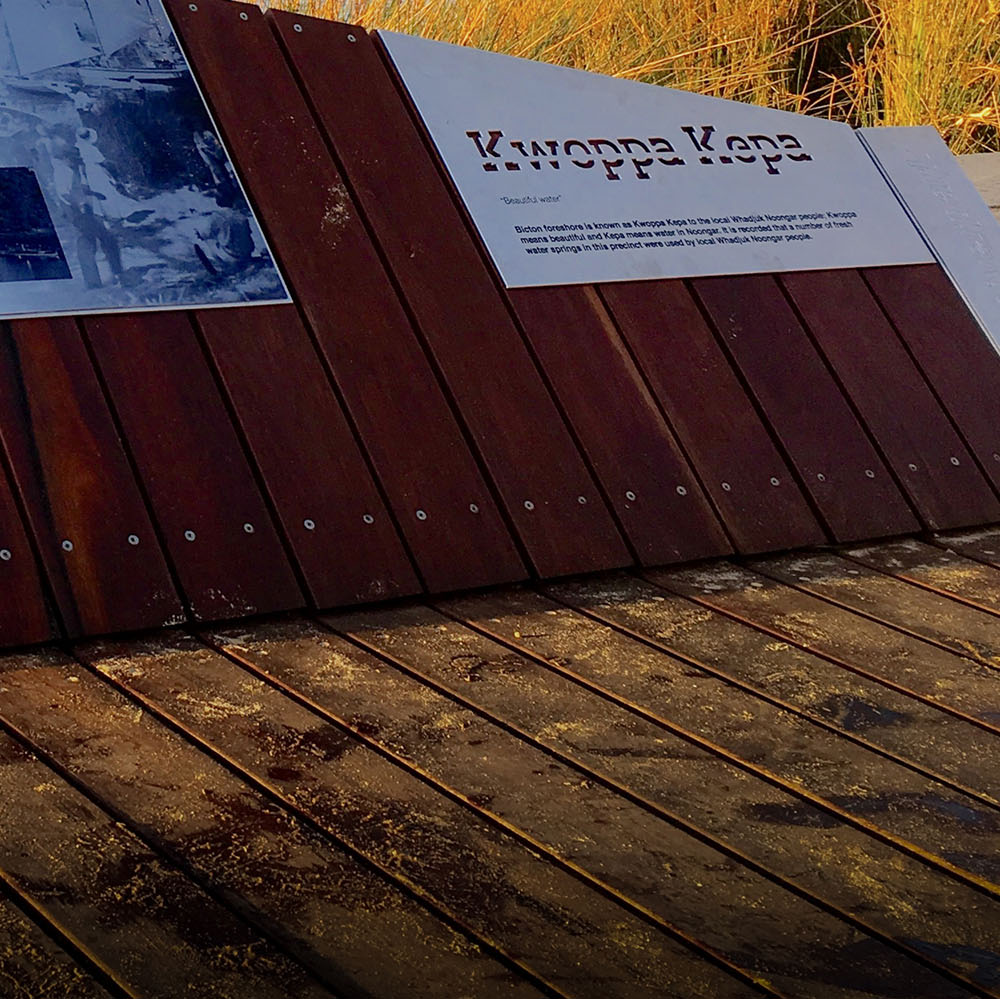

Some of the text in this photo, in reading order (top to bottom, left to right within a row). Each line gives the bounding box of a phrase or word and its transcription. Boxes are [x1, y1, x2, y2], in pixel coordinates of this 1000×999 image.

[465, 125, 813, 181] Kwoppa Kepa
[514, 224, 543, 234] Bicton
[543, 222, 584, 232] foreshore
[584, 222, 593, 230] is
[593, 221, 621, 230] known
[633, 219, 666, 230] Kwoppa
[666, 218, 687, 228] Kepa
[687, 218, 697, 226] to
[697, 217, 710, 225] the
[711, 216, 730, 225] local
[731, 215, 765, 225] Whadjuk
[765, 213, 797, 224] Noongar
[826, 211, 857, 221] Kwoppa
[520, 236, 548, 244] means
[549, 232, 585, 242] beautiful
[586, 232, 602, 240] and
[603, 231, 625, 242] Kepa
[625, 231, 653, 239] means
[653, 228, 675, 237] water
[676, 228, 685, 236] in
[721, 226, 728, 234] It
[728, 226, 737, 234] is
[737, 224, 771, 233] recorded
[772, 223, 787, 231] that
[794, 222, 823, 230] number
[823, 221, 832, 229] of
[832, 220, 852, 228] fresh
[525, 245, 548, 254] water
[550, 243, 582, 255] springs
[582, 243, 591, 251] in
[592, 242, 608, 251] this
[609, 240, 642, 252] precinct
[663, 238, 684, 247] used
[684, 238, 695, 248] by
[696, 237, 715, 245] local
[716, 235, 750, 246] Whadjuk
[750, 234, 783, 244] Noongar
[784, 232, 813, 242] people.
